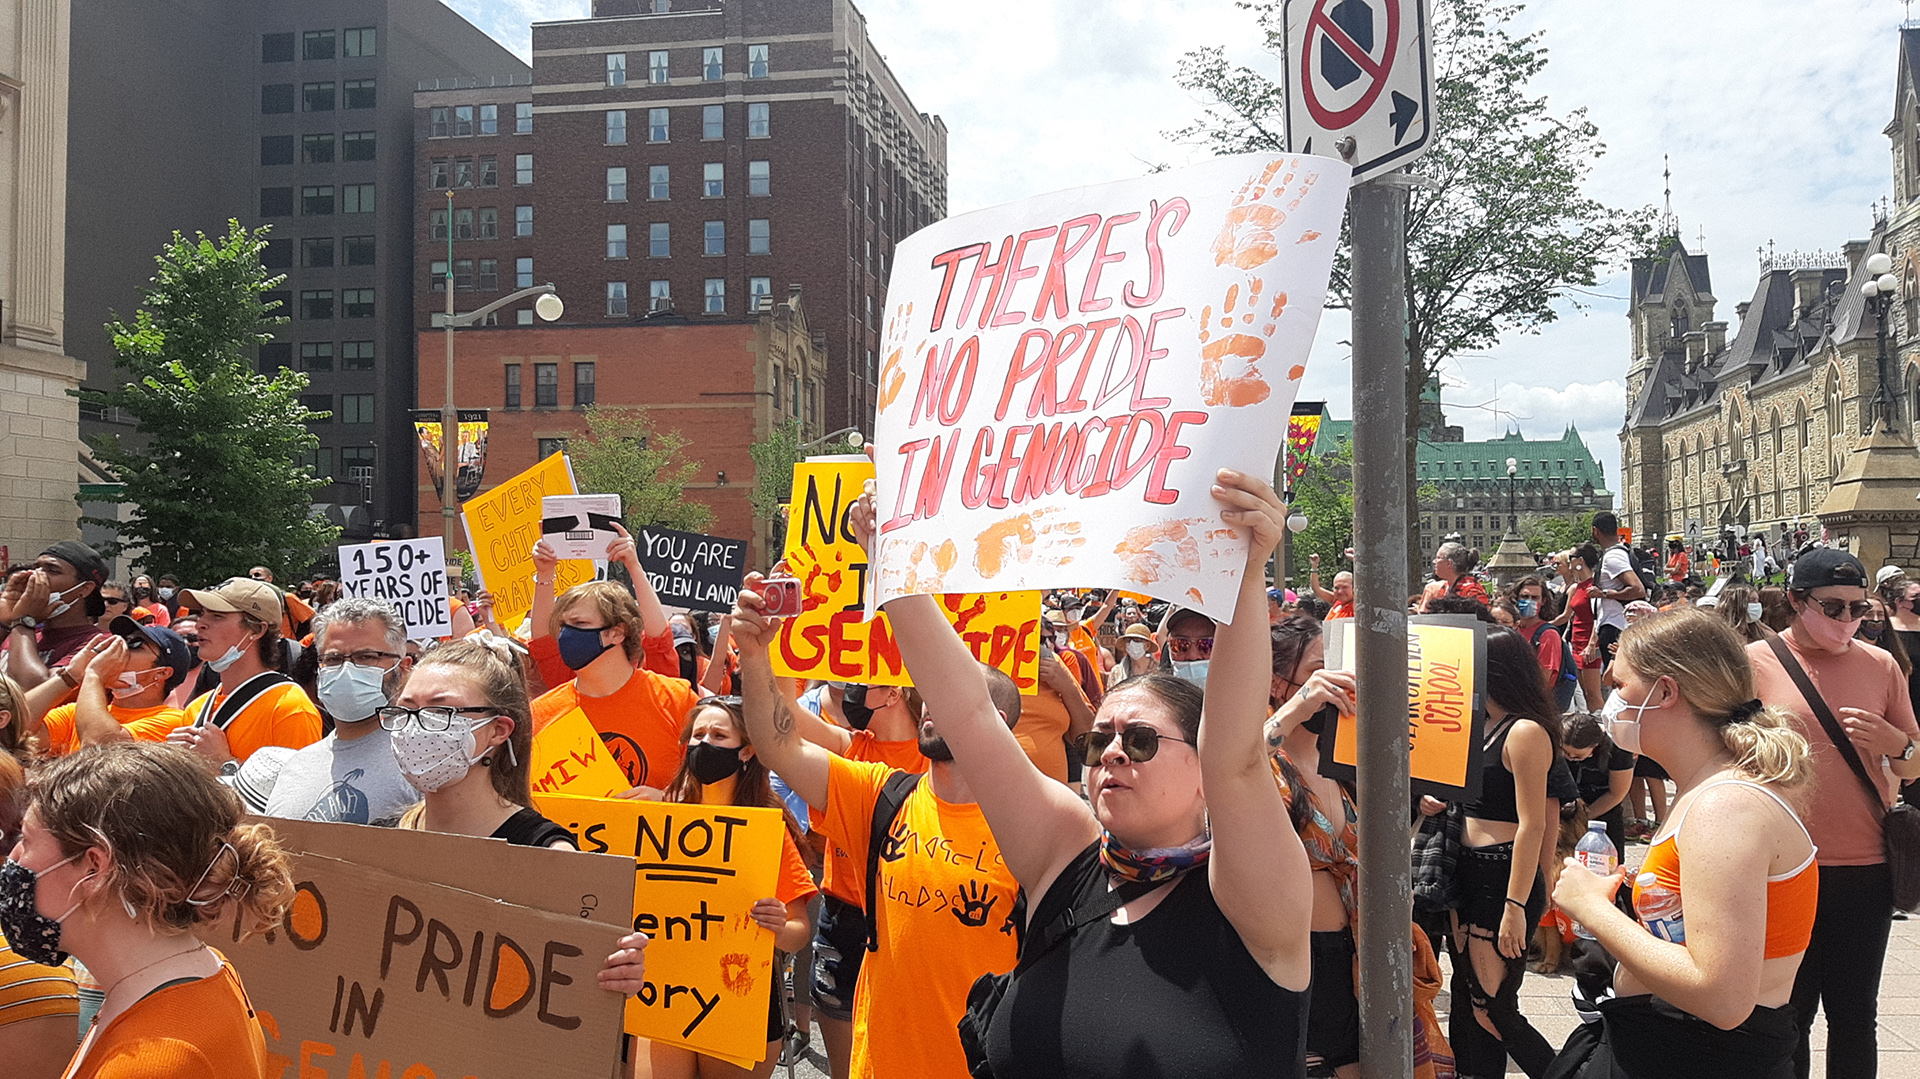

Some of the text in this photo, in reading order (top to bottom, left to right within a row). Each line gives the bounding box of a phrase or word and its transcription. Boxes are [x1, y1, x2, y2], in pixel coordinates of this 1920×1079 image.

[930, 197, 1191, 332] THERE'S
[909, 307, 1186, 428] NO PRIDE
[880, 408, 1209, 535] IN GENOCIDE
[477, 470, 546, 532] EVERY
[353, 544, 431, 576] 150+
[490, 520, 541, 572] CHIL
[643, 530, 738, 569] YOU ARE
[671, 561, 694, 575] ON
[345, 570, 442, 599] YEARS OF
[390, 597, 448, 626] OCIDE
[493, 558, 581, 617] MATRS
[647, 572, 738, 605] TOLEN LAND
[780, 609, 1037, 688] GENIDE
[1423, 658, 1464, 733] SCHOOL
[635, 815, 748, 862] NOT
[634, 900, 725, 941] ent
[380, 895, 584, 1031] PRIDE
[329, 975, 385, 1039] IN
[637, 981, 721, 1038] ory
